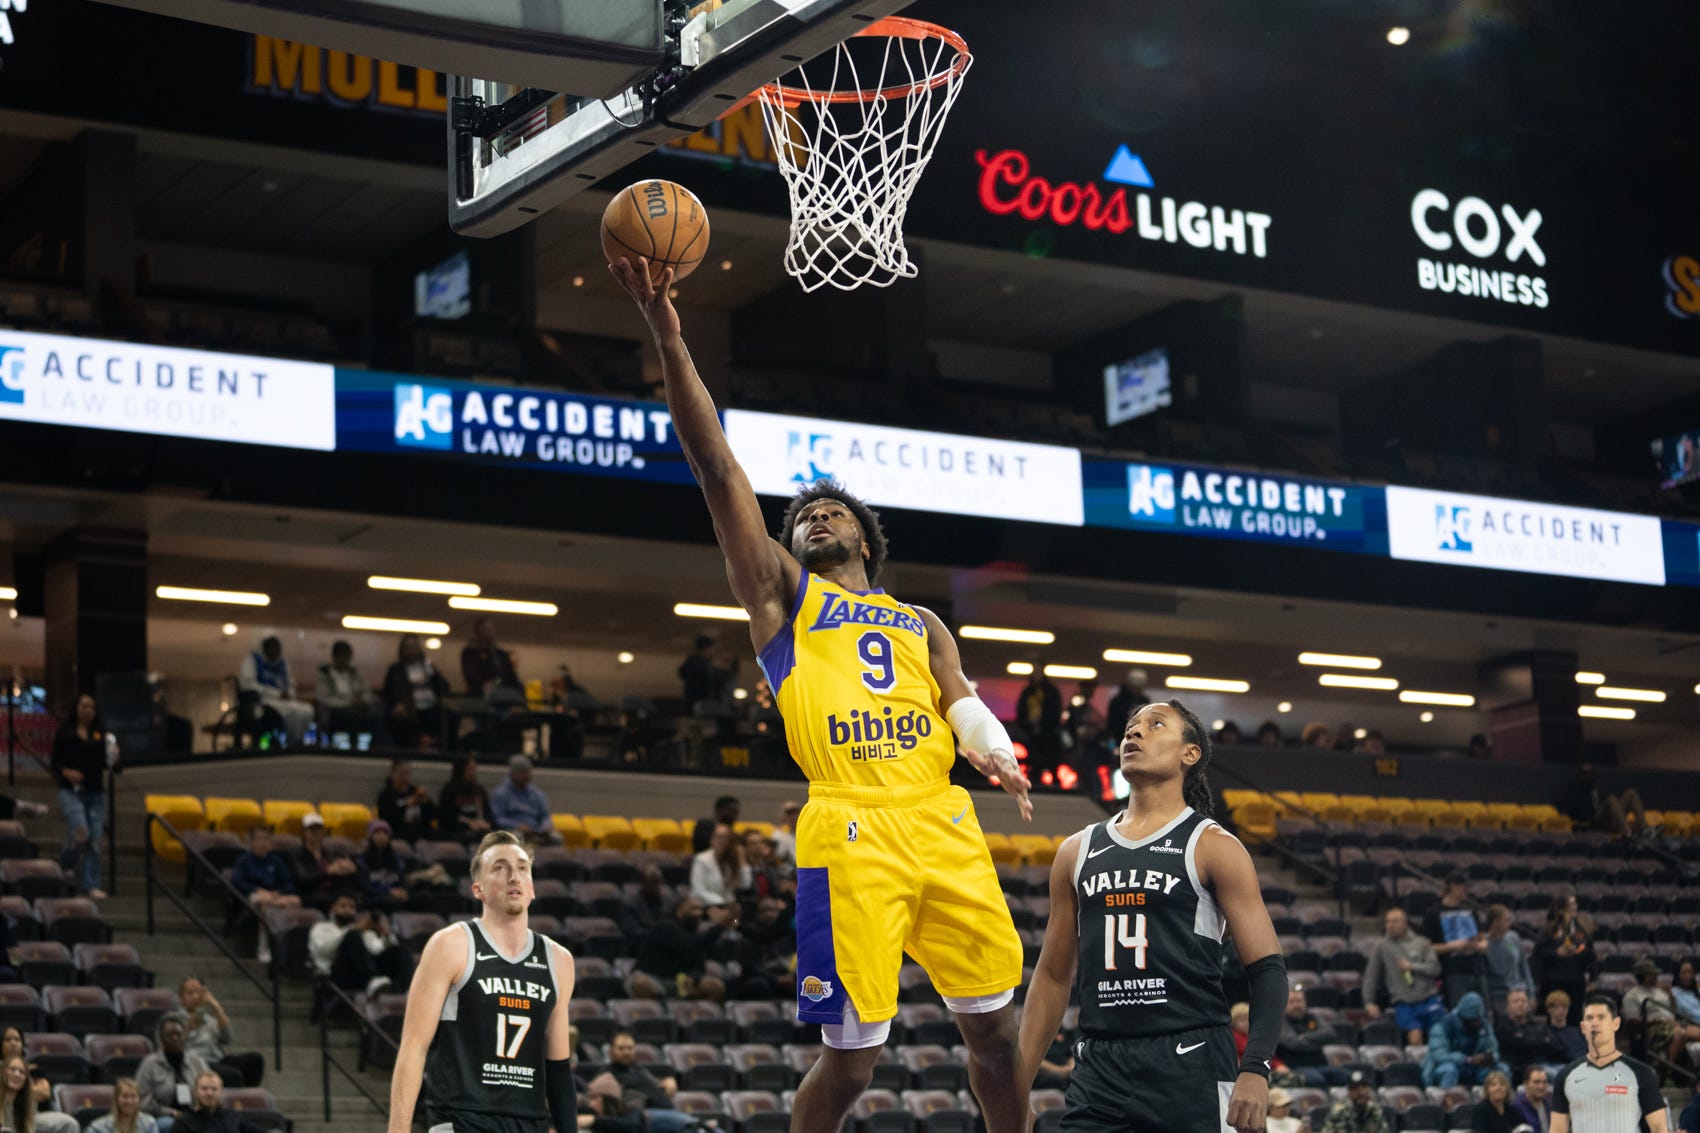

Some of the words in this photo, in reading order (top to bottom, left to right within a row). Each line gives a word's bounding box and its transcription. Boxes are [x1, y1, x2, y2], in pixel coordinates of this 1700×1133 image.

[975, 150, 1133, 234] Coors
[1136, 193, 1272, 258] LIGHT
[1411, 188, 1547, 267] COX
[1417, 258, 1549, 309] BUSINESS
[42, 351, 270, 399] ACCIDENT
[462, 390, 672, 445] ACCIDENT
[462, 428, 526, 458] LAW
[849, 438, 1028, 479] ACCIDENT
[1181, 470, 1346, 517] ACCIDENT
[1183, 504, 1232, 530] LAW
[1482, 510, 1622, 546] ACCIDENT
[808, 592, 924, 637] LAKERS
[856, 630, 897, 695] 9
[827, 706, 932, 750] bibigo
[851, 742, 898, 761] 비비고
[1149, 846, 1183, 854] GOODWILL
[1082, 869, 1181, 897] VALLEY
[1105, 893, 1146, 907] SUNS
[1104, 913, 1148, 970] 14
[477, 977, 551, 1002] VALLEY
[499, 996, 531, 1010] SUNS
[1098, 980, 1122, 991] GILA
[1123, 978, 1166, 990] RIVER
[496, 1012, 531, 1060] 17
[482, 1063, 507, 1073] GILA
[508, 1065, 534, 1077] RIVER
